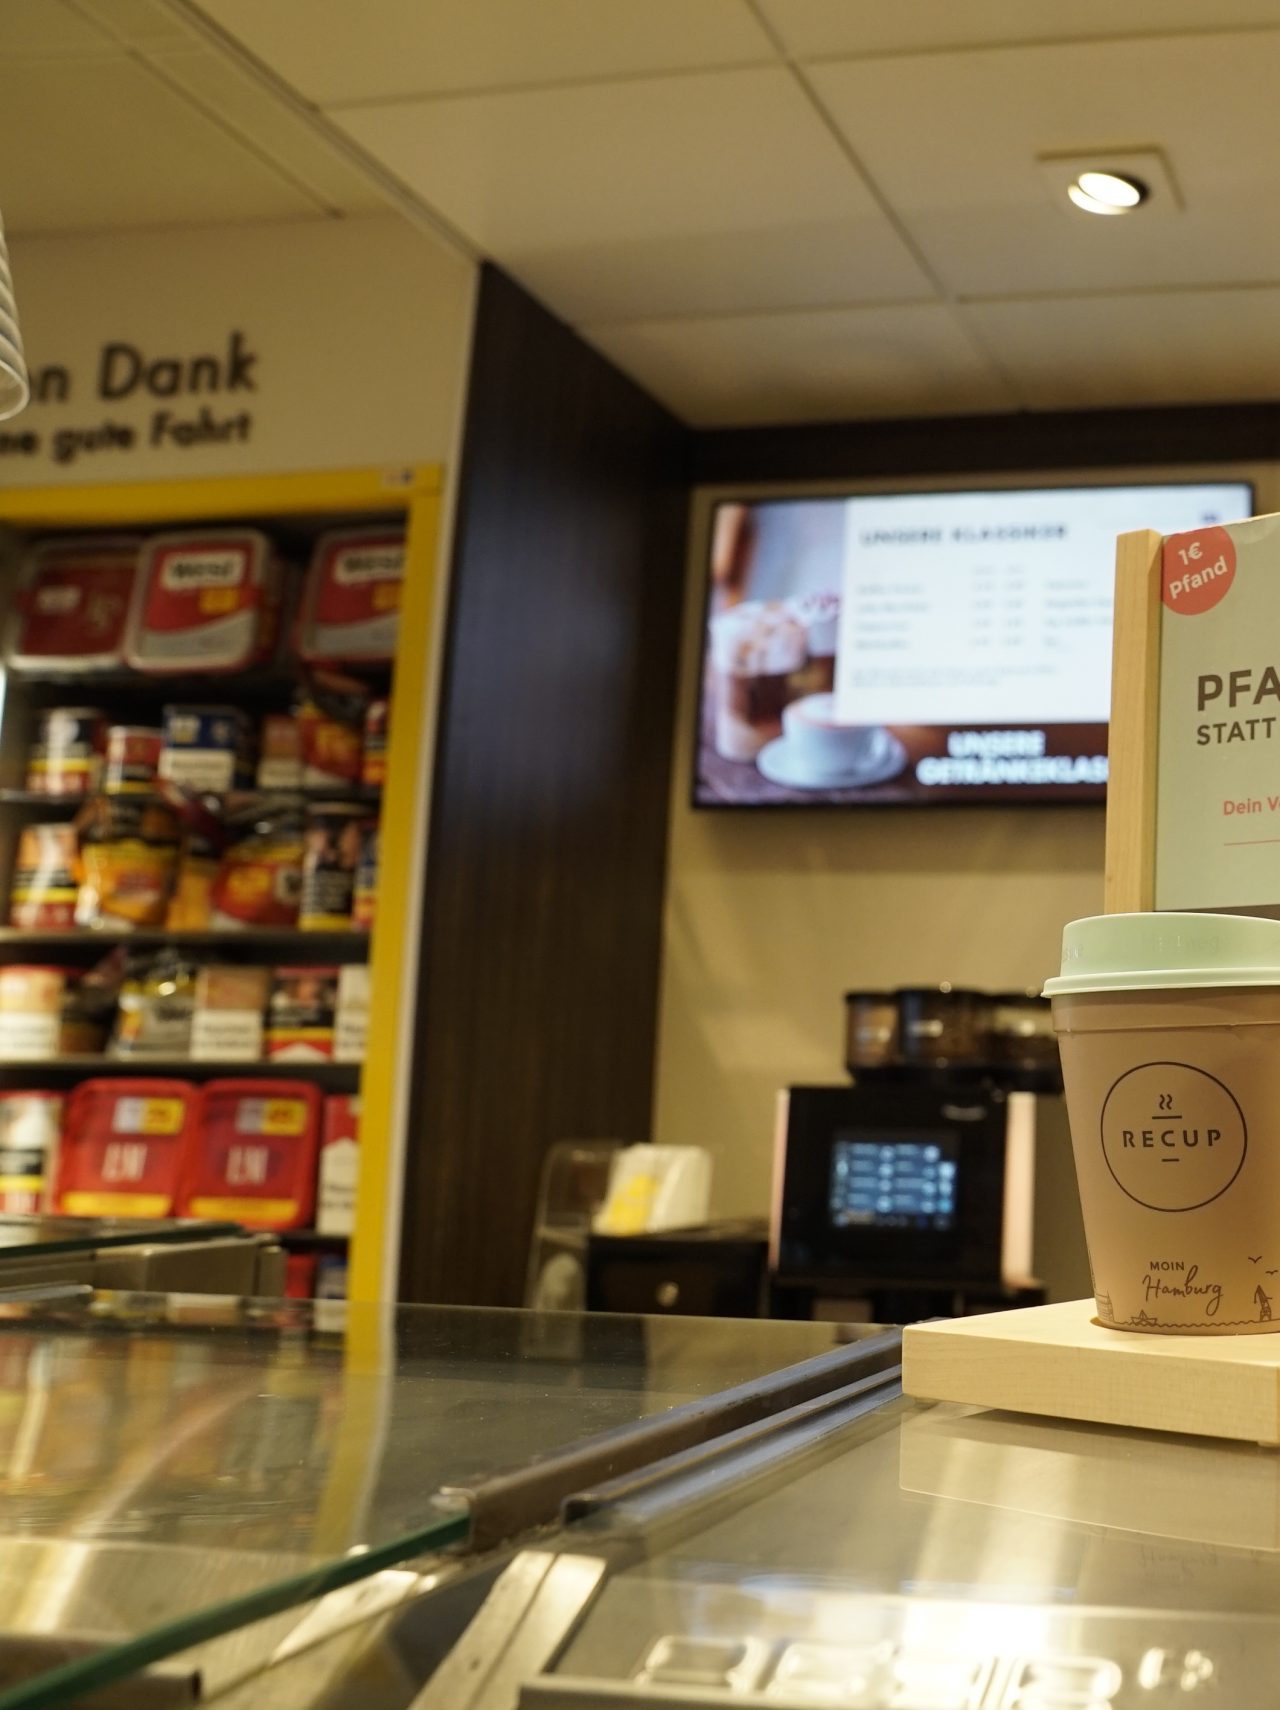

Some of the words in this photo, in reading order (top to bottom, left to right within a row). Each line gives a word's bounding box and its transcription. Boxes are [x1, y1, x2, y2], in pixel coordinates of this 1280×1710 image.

[100, 330, 258, 400] Dank
[54, 421, 136, 464] gute
[151, 407, 253, 447] Fahrt
[1179, 542, 1203, 565] 1€
[1169, 556, 1228, 599] Pfand
[1197, 717, 1276, 745] STATT
[1223, 799, 1262, 816] Dein
[1122, 1129, 1221, 1148] RECUP
[1150, 1261, 1185, 1271] MOIN
[1142, 1265, 1224, 1316] Hamburg
